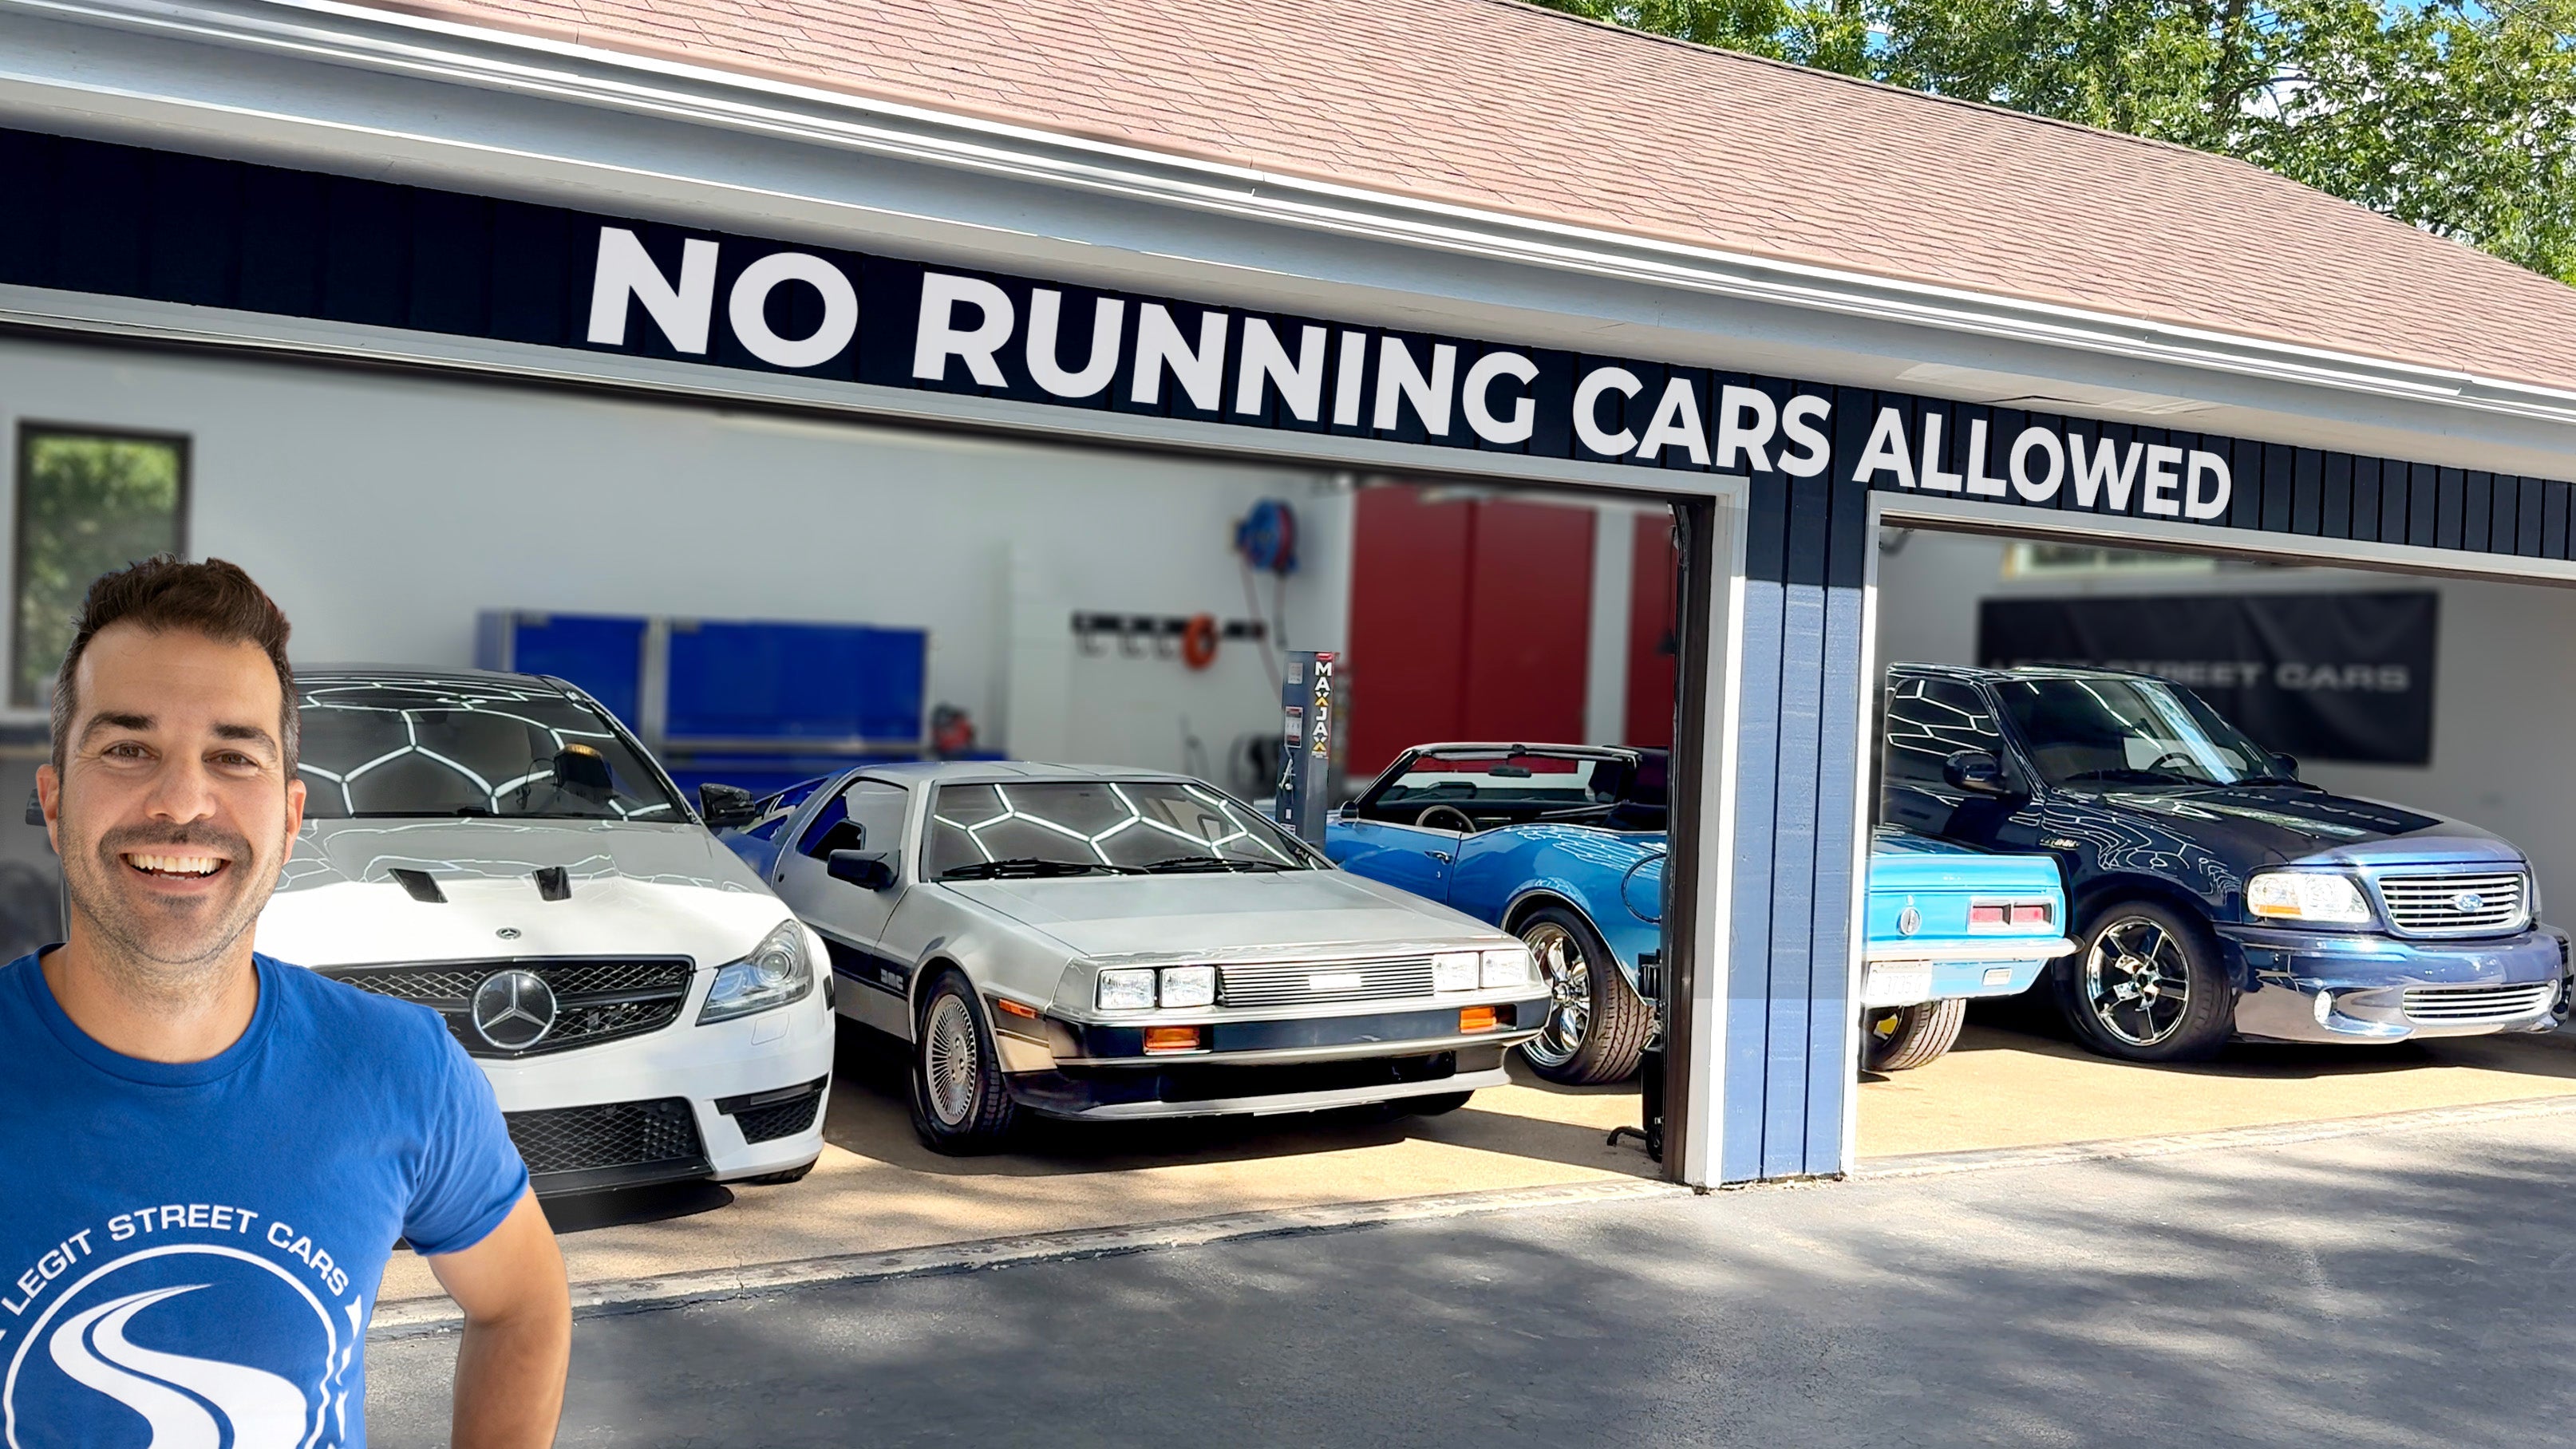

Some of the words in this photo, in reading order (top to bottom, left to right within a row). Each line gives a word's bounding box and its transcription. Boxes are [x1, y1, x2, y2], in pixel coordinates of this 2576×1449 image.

[587, 227, 859, 369] NO
[912, 272, 1539, 444] RUNNING
[1573, 366, 1831, 478] CARS
[1851, 407, 2232, 519] ALLOWED
[2274, 661, 2410, 693] CARS
[2, 1229, 91, 1317] LEGIT
[108, 1204, 259, 1242] STREET
[267, 1222, 349, 1297] CARS
